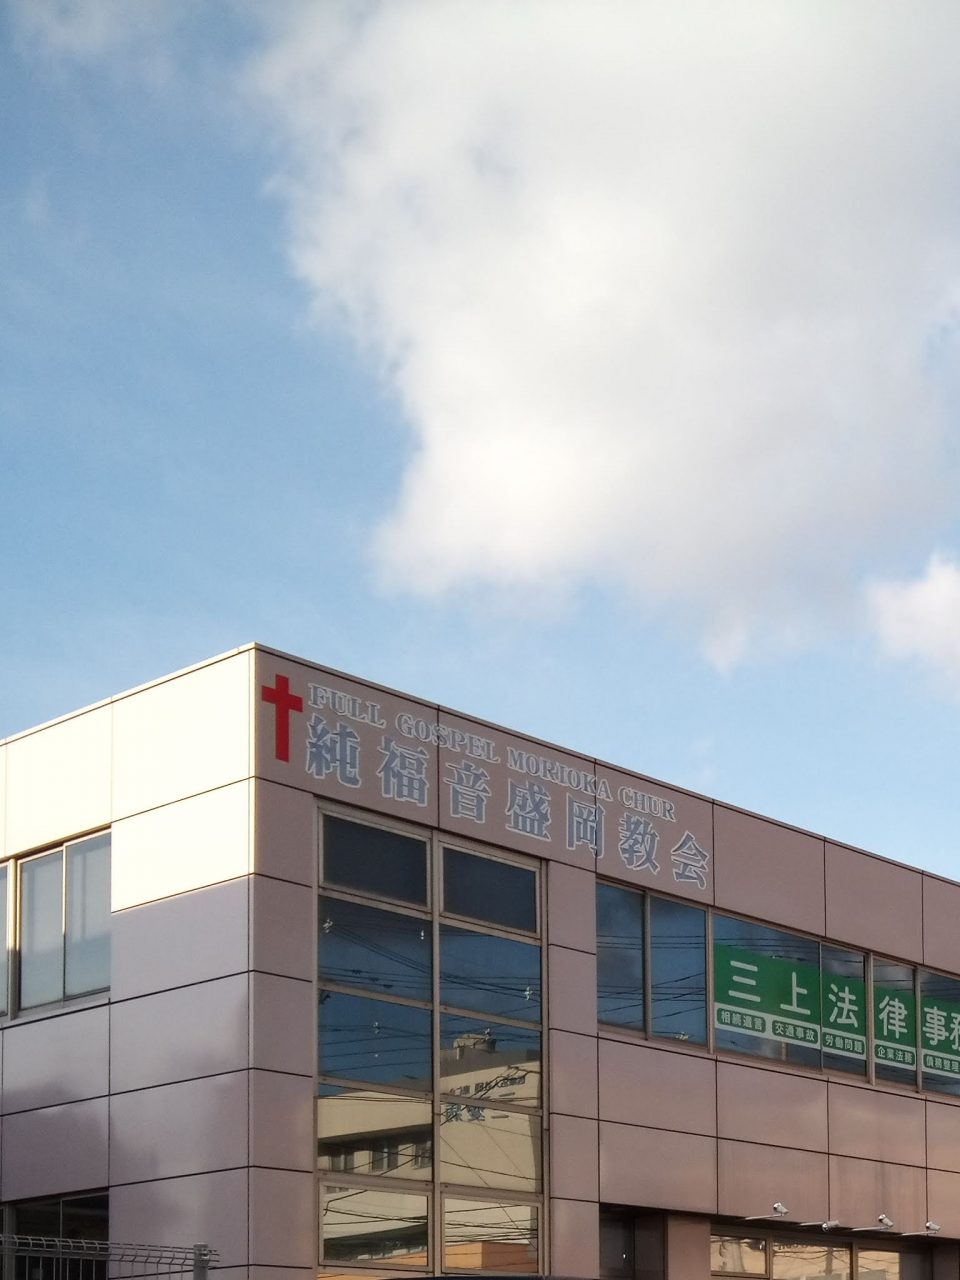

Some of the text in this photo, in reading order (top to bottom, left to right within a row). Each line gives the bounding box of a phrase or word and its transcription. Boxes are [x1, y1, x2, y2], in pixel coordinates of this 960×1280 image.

[305, 713, 710, 889] 純福音盛岡教会
[308, 683, 676, 822] FULL GOSPEL MORIOKA CHUR
[775, 1022, 815, 1041] 交通事故
[825, 1034, 863, 1053] 労働問題
[877, 1046, 913, 1064] 企業法務
[926, 1056, 960, 1073] 債務整理
